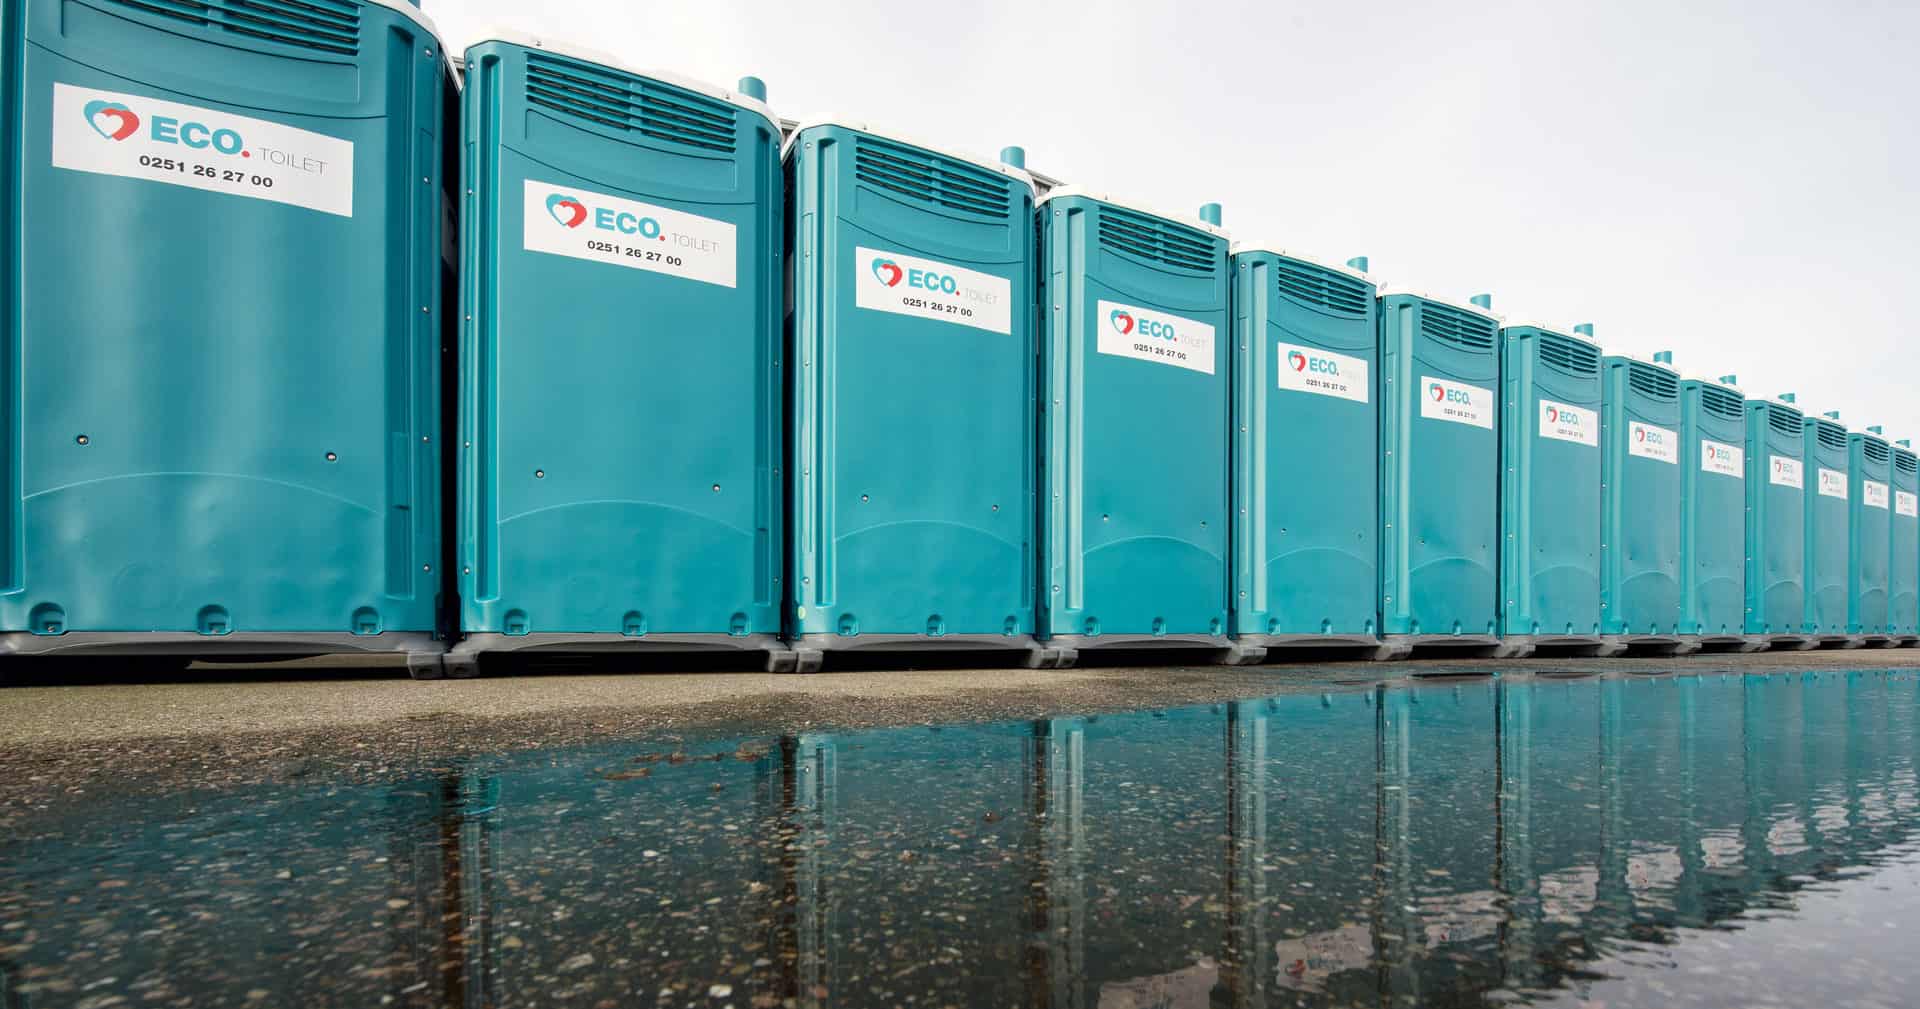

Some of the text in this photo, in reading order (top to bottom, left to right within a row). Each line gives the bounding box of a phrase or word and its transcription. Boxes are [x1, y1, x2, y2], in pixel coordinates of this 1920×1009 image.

[150, 115, 328, 177] ECO. TOILET
[139, 155, 273, 188] 0251 26 27 00
[595, 207, 719, 254] ECO. TOILET
[587, 240, 682, 266] 0251 26 27 00
[908, 268, 961, 296] ECO.
[902, 297, 973, 317] 0251 26 27 00
[1138, 318, 1178, 342] ECO.
[1133, 343, 1153, 353] 0251
[1166, 349, 1176, 358] 27
[1309, 357, 1340, 377] ECO.
[1447, 388, 1472, 406] ECO.
